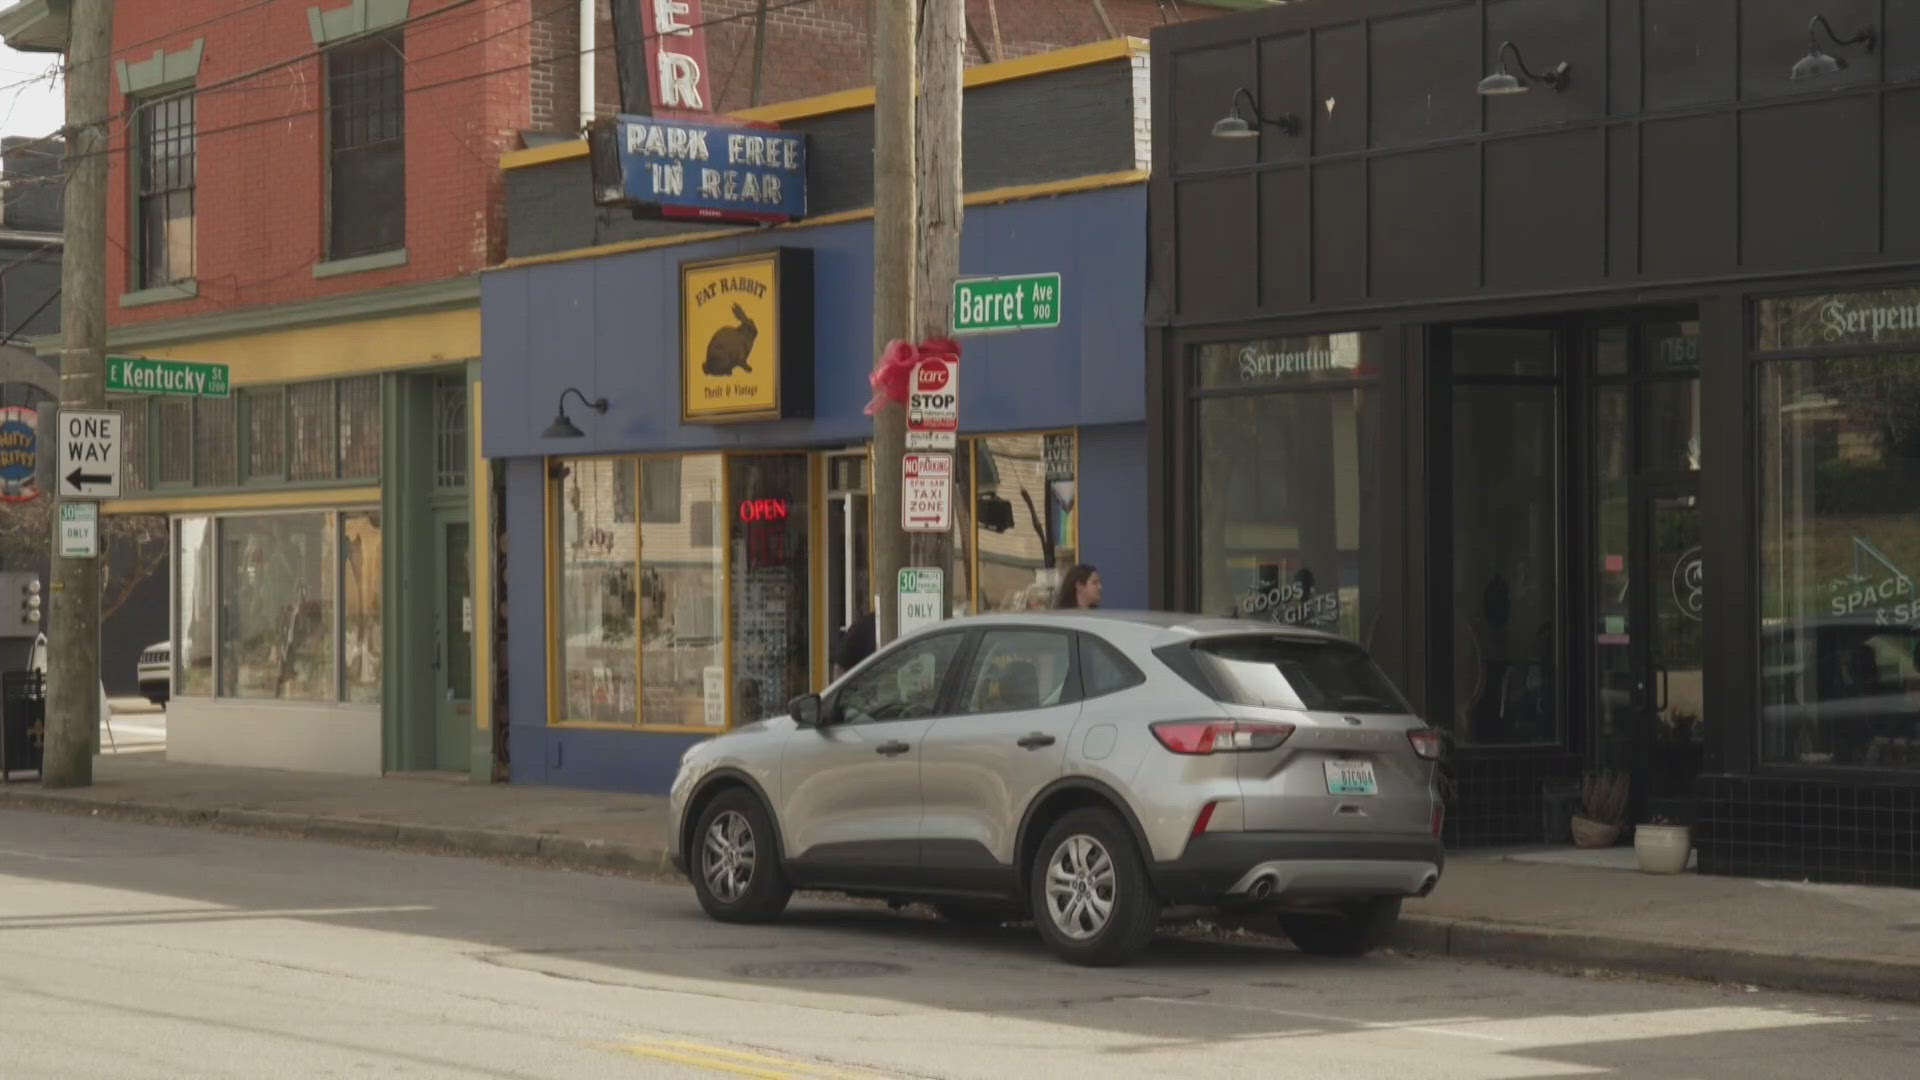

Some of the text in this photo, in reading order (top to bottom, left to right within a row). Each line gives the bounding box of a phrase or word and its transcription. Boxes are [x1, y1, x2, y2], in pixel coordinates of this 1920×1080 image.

[626, 123, 799, 170] PARK FREE
[651, 162, 782, 204] IN REAR
[696, 277, 767, 308] FAT RABBIT
[960, 282, 1053, 324] Barret Ave
[1033, 305, 1051, 320] 900
[111, 362, 222, 393] E Kentucky St
[919, 367, 946, 384] tarc
[208, 381, 226, 393] 1200
[704, 386, 723, 399] Thrift
[734, 385, 758, 398] Vintage
[911, 394, 955, 409] STOP
[69, 418, 111, 439] ONE
[68, 442, 112, 462] WAY
[905, 459, 949, 475] NO PARKING
[914, 489, 942, 500] TAXI
[61, 504, 75, 520] 30
[740, 500, 787, 521] OPEN
[910, 501, 944, 512] ZONE
[67, 527, 89, 538] ONLY
[901, 572, 916, 590] 30
[1243, 581, 1304, 613] GOODS
[1831, 576, 1909, 616] SPACE
[907, 603, 933, 618] ONLY
[1285, 592, 1338, 623] GIFTS
[1875, 608, 1889, 625] &
